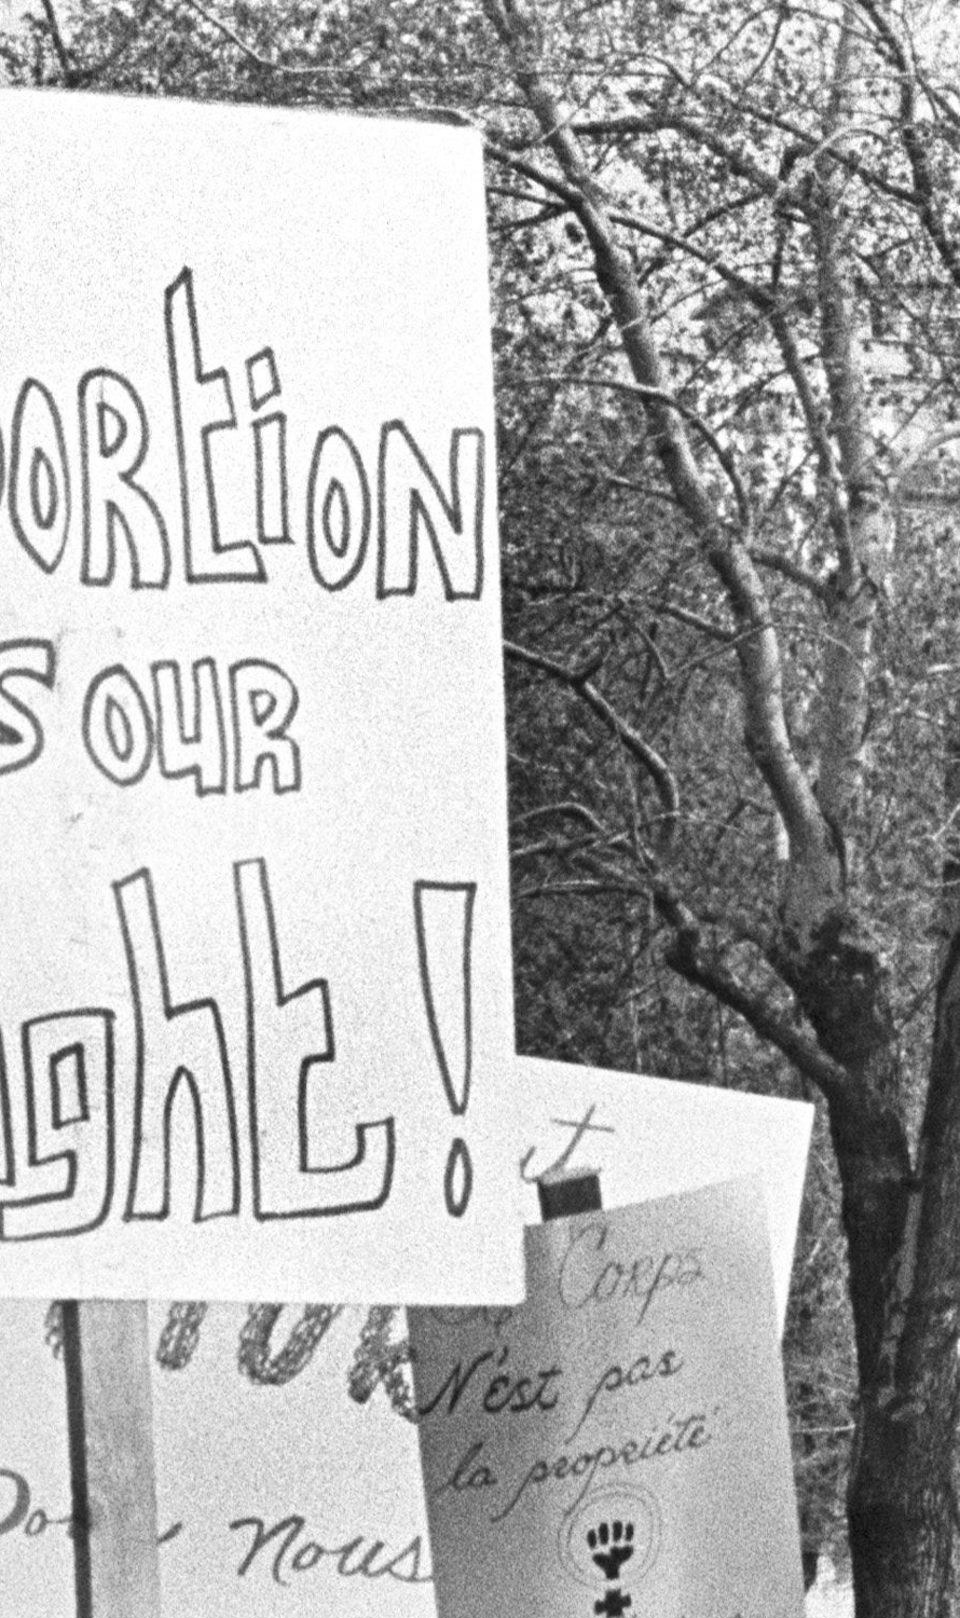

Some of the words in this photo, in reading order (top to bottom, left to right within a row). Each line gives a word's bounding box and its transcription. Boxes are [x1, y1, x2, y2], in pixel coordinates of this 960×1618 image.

[558, 1223, 706, 1326] Corps
[418, 1345, 563, 1416] N'est
[565, 1348, 685, 1445] pas
[434, 1442, 497, 1492] la
[229, 1514, 434, 1586] Nous
